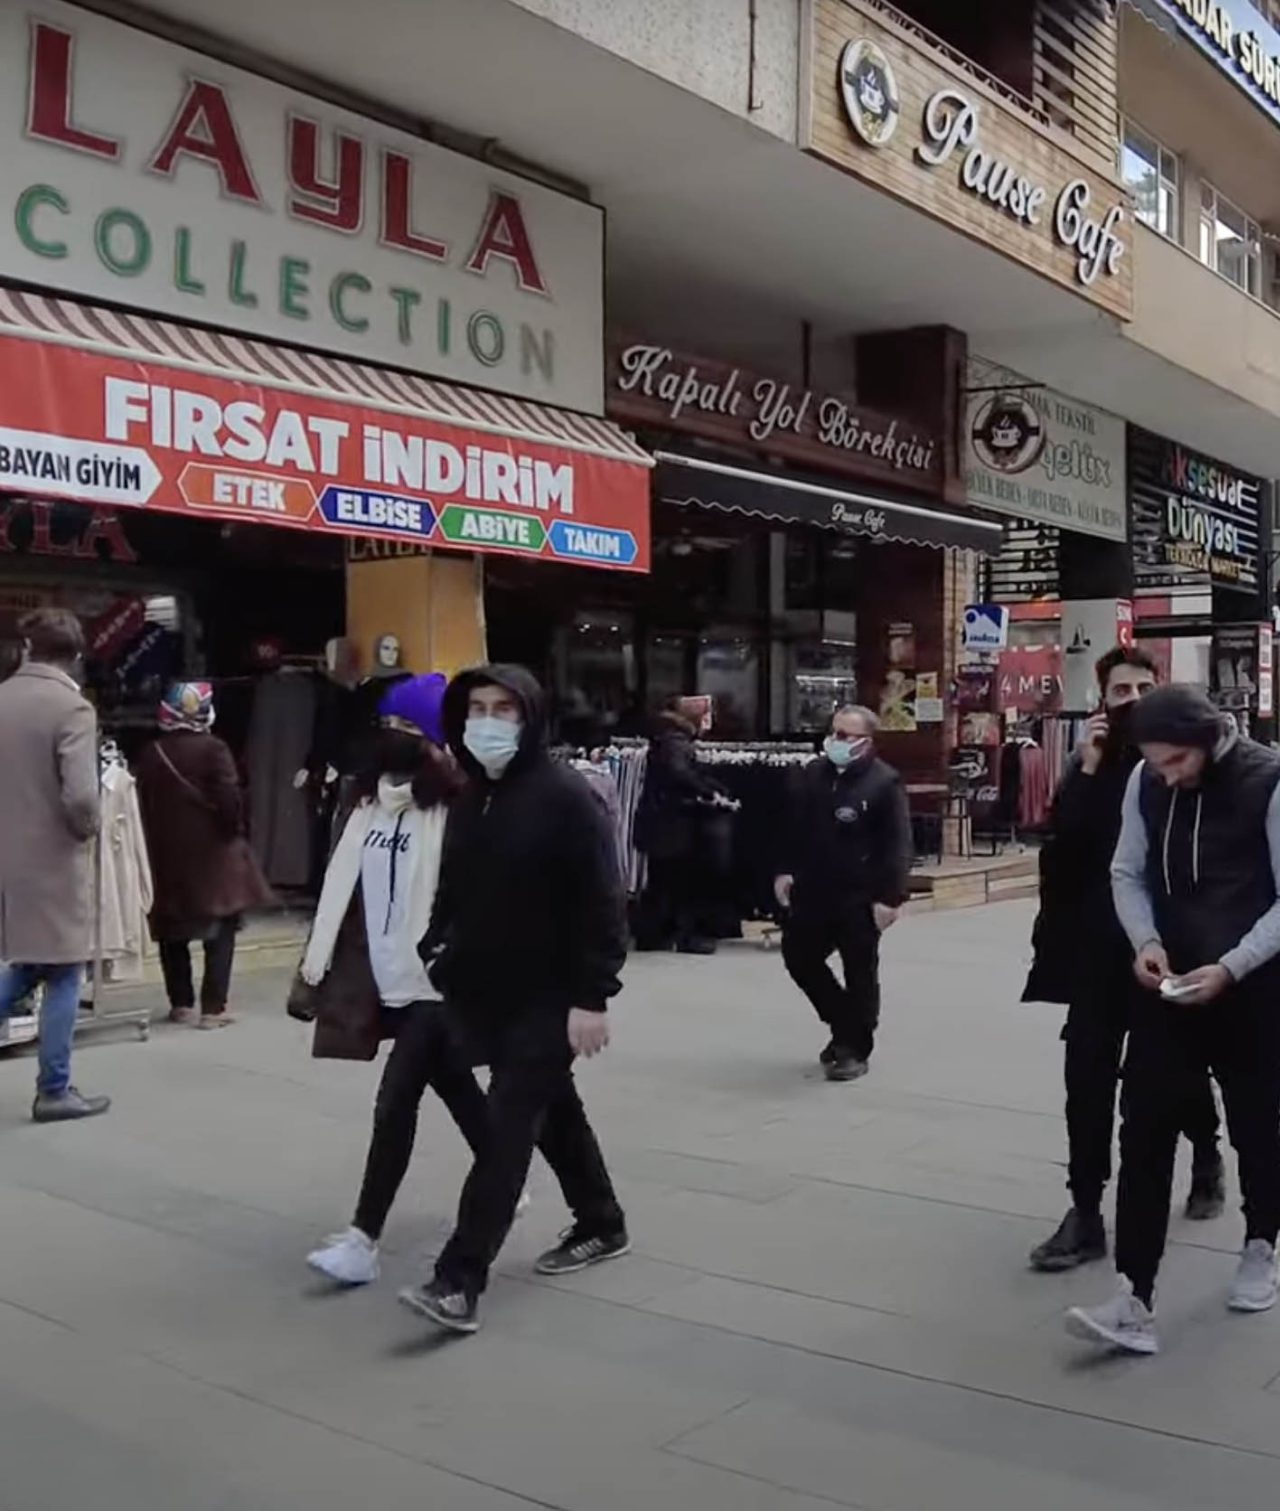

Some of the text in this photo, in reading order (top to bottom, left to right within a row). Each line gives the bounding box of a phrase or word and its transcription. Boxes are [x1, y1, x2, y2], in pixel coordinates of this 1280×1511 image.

[24, 17, 556, 304] LAYLA
[917, 89, 1125, 285] Pause Cafe
[13, 182, 556, 382] COLLECTION
[103, 375, 348, 478] FIRSAT
[618, 345, 935, 470] Kapalı Yol Börekçisi
[0, 446, 141, 491] BAYAN GİYİM
[213, 472, 287, 511] ETEK
[563, 527, 621, 558] TAKIM
[1167, 496, 1240, 555] Dünyası
